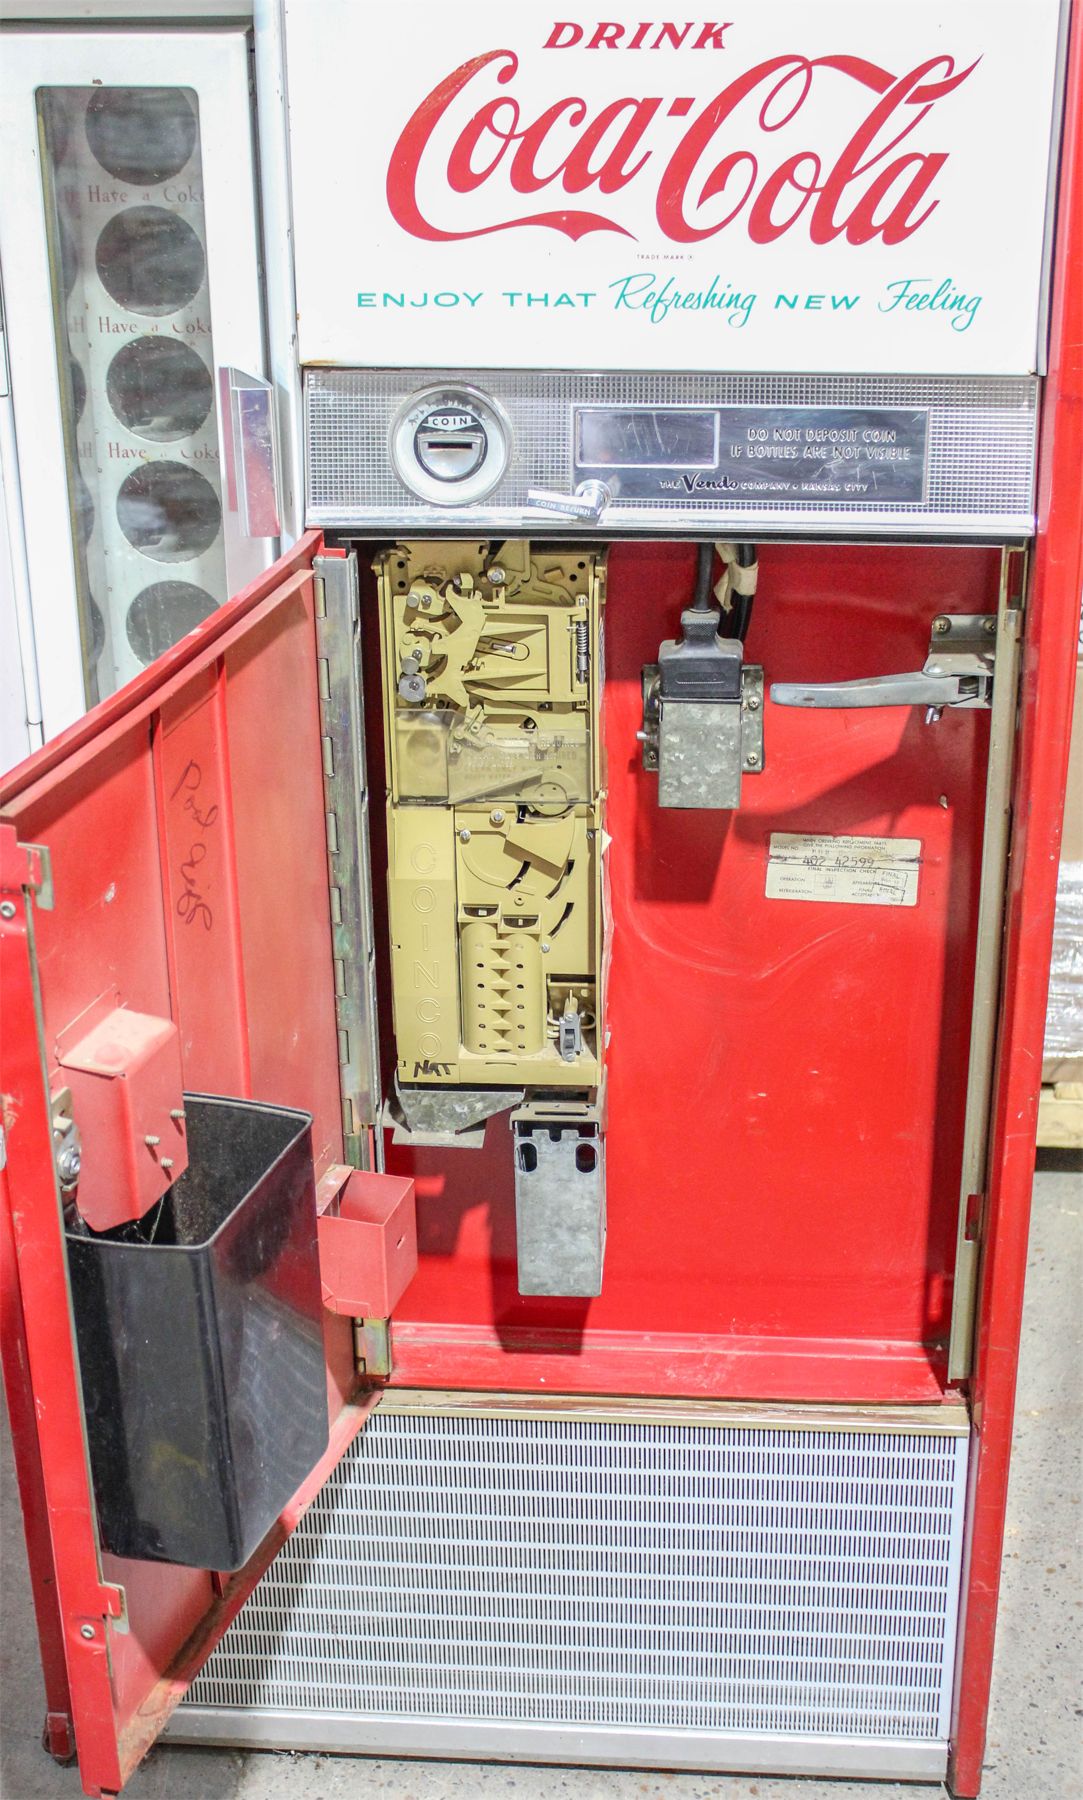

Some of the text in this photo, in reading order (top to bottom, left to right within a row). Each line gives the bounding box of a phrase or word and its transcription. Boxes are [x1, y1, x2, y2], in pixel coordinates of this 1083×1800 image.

[541, 21, 735, 50] DRINK
[386, 48, 985, 246] Coca-Cola
[88, 184, 128, 203] Have
[356, 272, 983, 332] ENJOY THAT Refreshing NEW Feeling
[98, 315, 138, 334] Have
[432, 417, 468, 427] COIN
[747, 428, 897, 444] DO NOT DEPOSIT COIN
[108, 442, 148, 459] Have
[730, 445, 911, 461] IF BOTTLES ARE NOT VISIBLE
[659, 473, 869, 494] THE Vendo COMPANY KANSAS CITY
[535, 499, 591, 516] COIN RETURN
[834, 855, 875, 869] 42599
[410, 842, 442, 1058] COINCO
